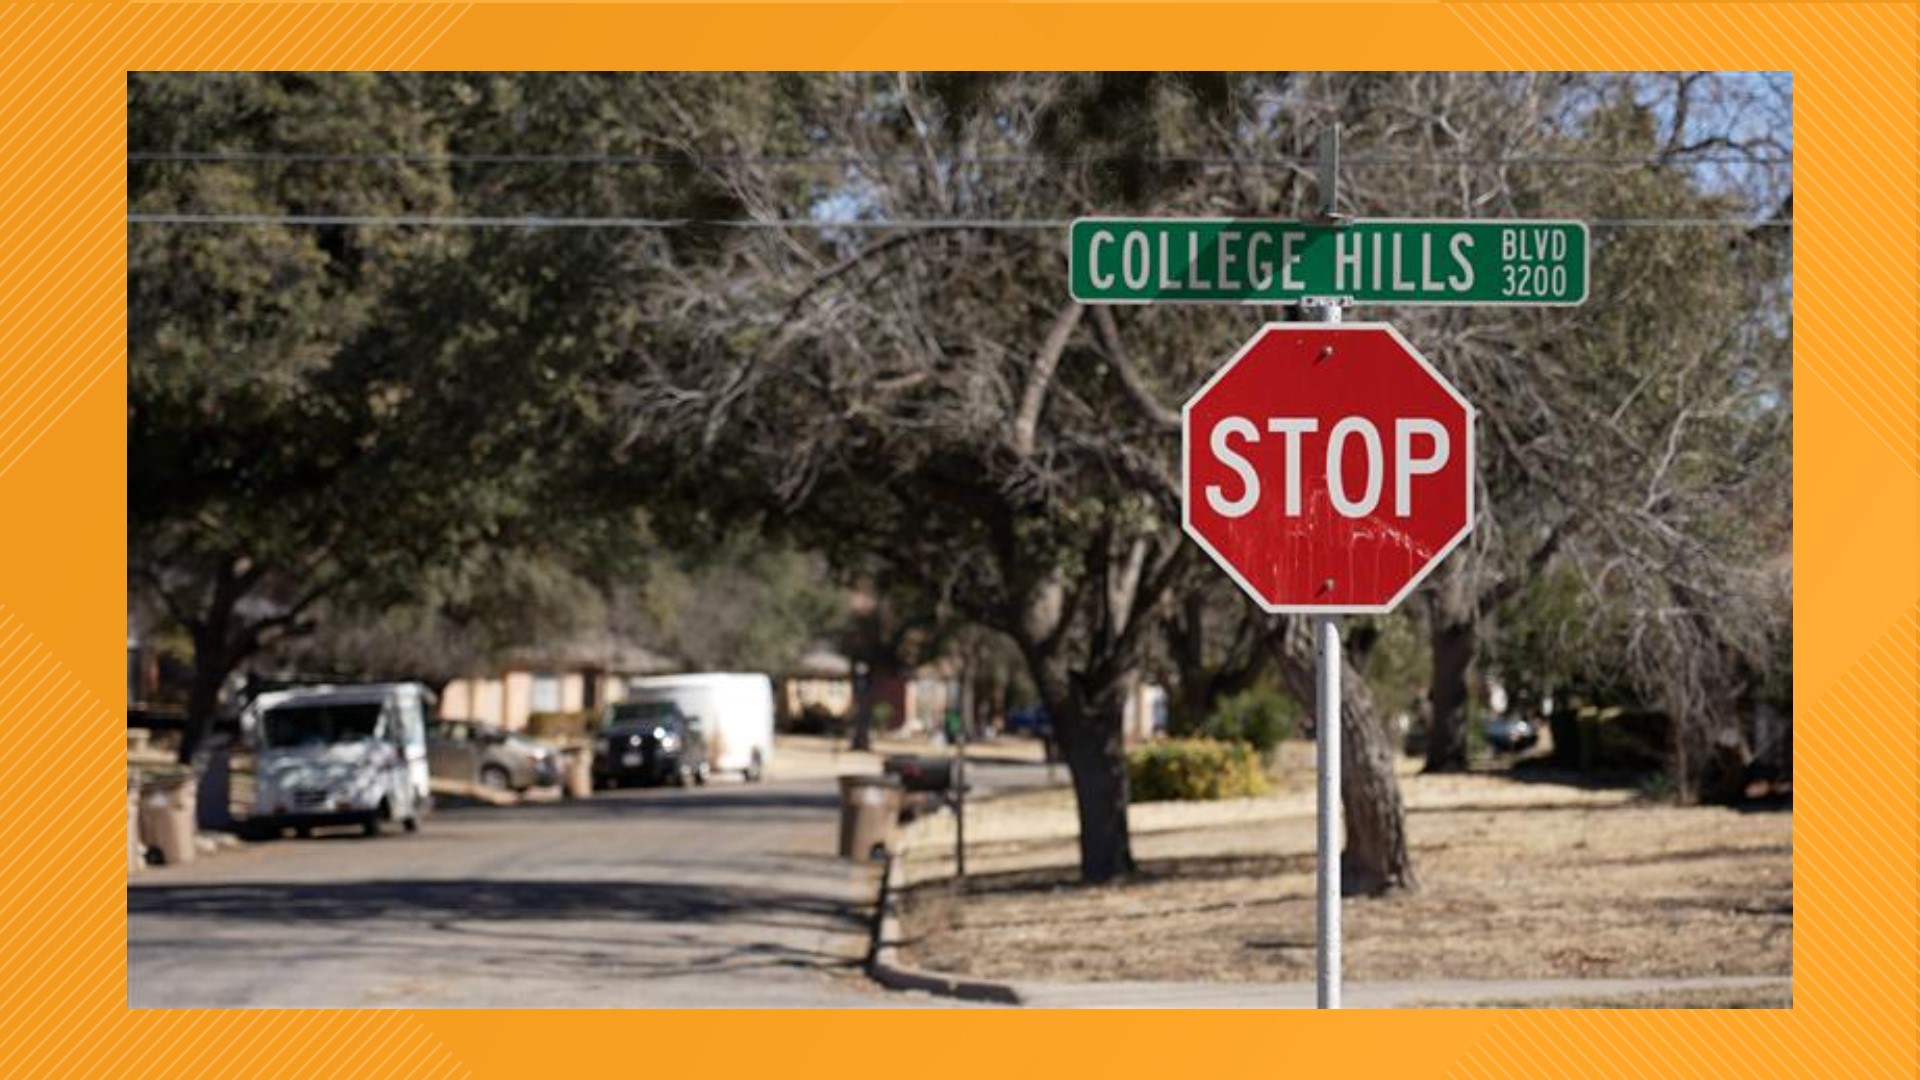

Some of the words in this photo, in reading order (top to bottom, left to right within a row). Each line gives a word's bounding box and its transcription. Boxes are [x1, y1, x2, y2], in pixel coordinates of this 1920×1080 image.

[1088, 230, 1307, 292] COLLEGE
[1335, 232, 1475, 292] HILLS
[1502, 229, 1567, 261] BLVD
[1502, 265, 1567, 297] 3200
[1205, 416, 1451, 518] STOP
